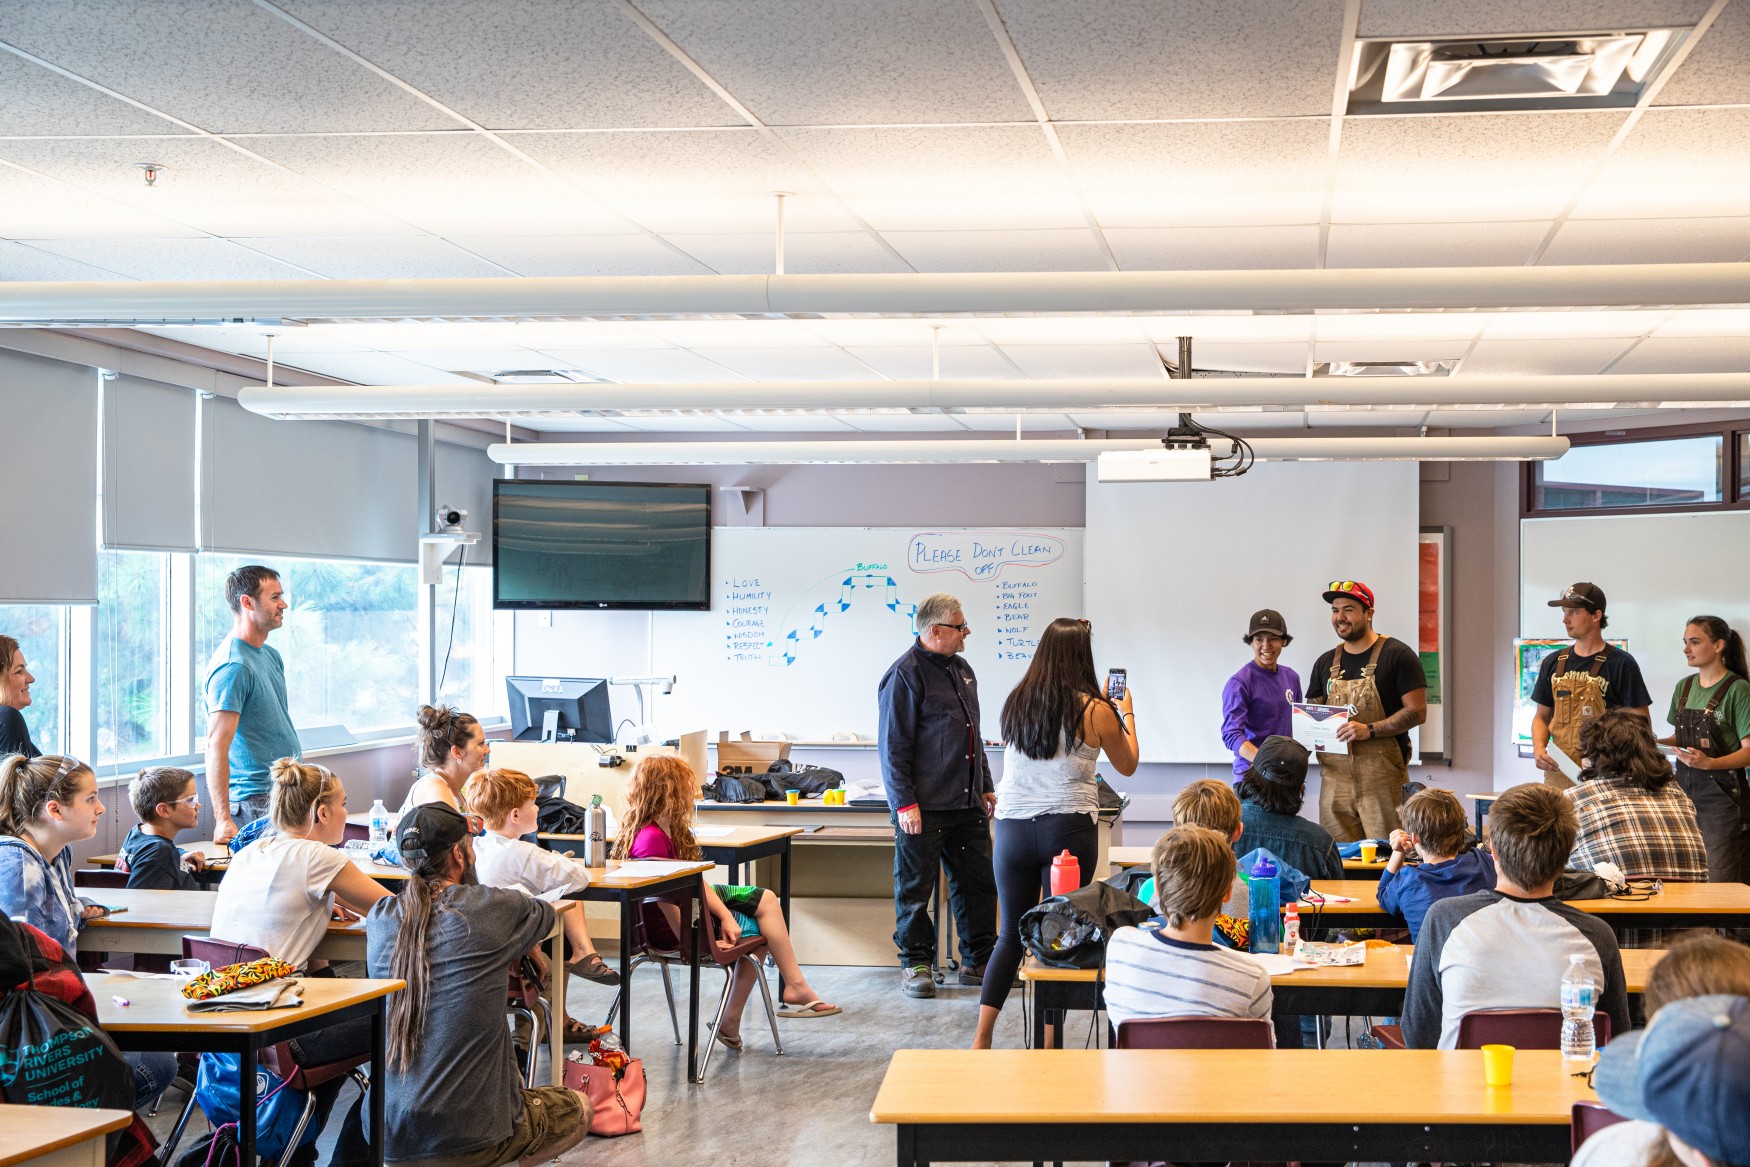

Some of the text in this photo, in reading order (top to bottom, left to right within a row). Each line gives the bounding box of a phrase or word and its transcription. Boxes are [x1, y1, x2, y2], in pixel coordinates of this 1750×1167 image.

[915, 542, 962, 563] PLEASE
[1011, 540, 1051, 556] CLEAN
[975, 563, 994, 575] OFF
[733, 578, 760, 587] LOVE
[732, 592, 771, 600] HUMILITY
[732, 607, 768, 615] HONESTY
[733, 619, 765, 627] COURAGE
[542, 685, 564, 693] DELL
[22, 1026, 94, 1056] THOMPSON
[24, 1045, 71, 1069] RIVERS
[25, 1045, 104, 1081] UNIVERSITY
[28, 1075, 84, 1102] School of
[72, 1091, 83, 1101] &
